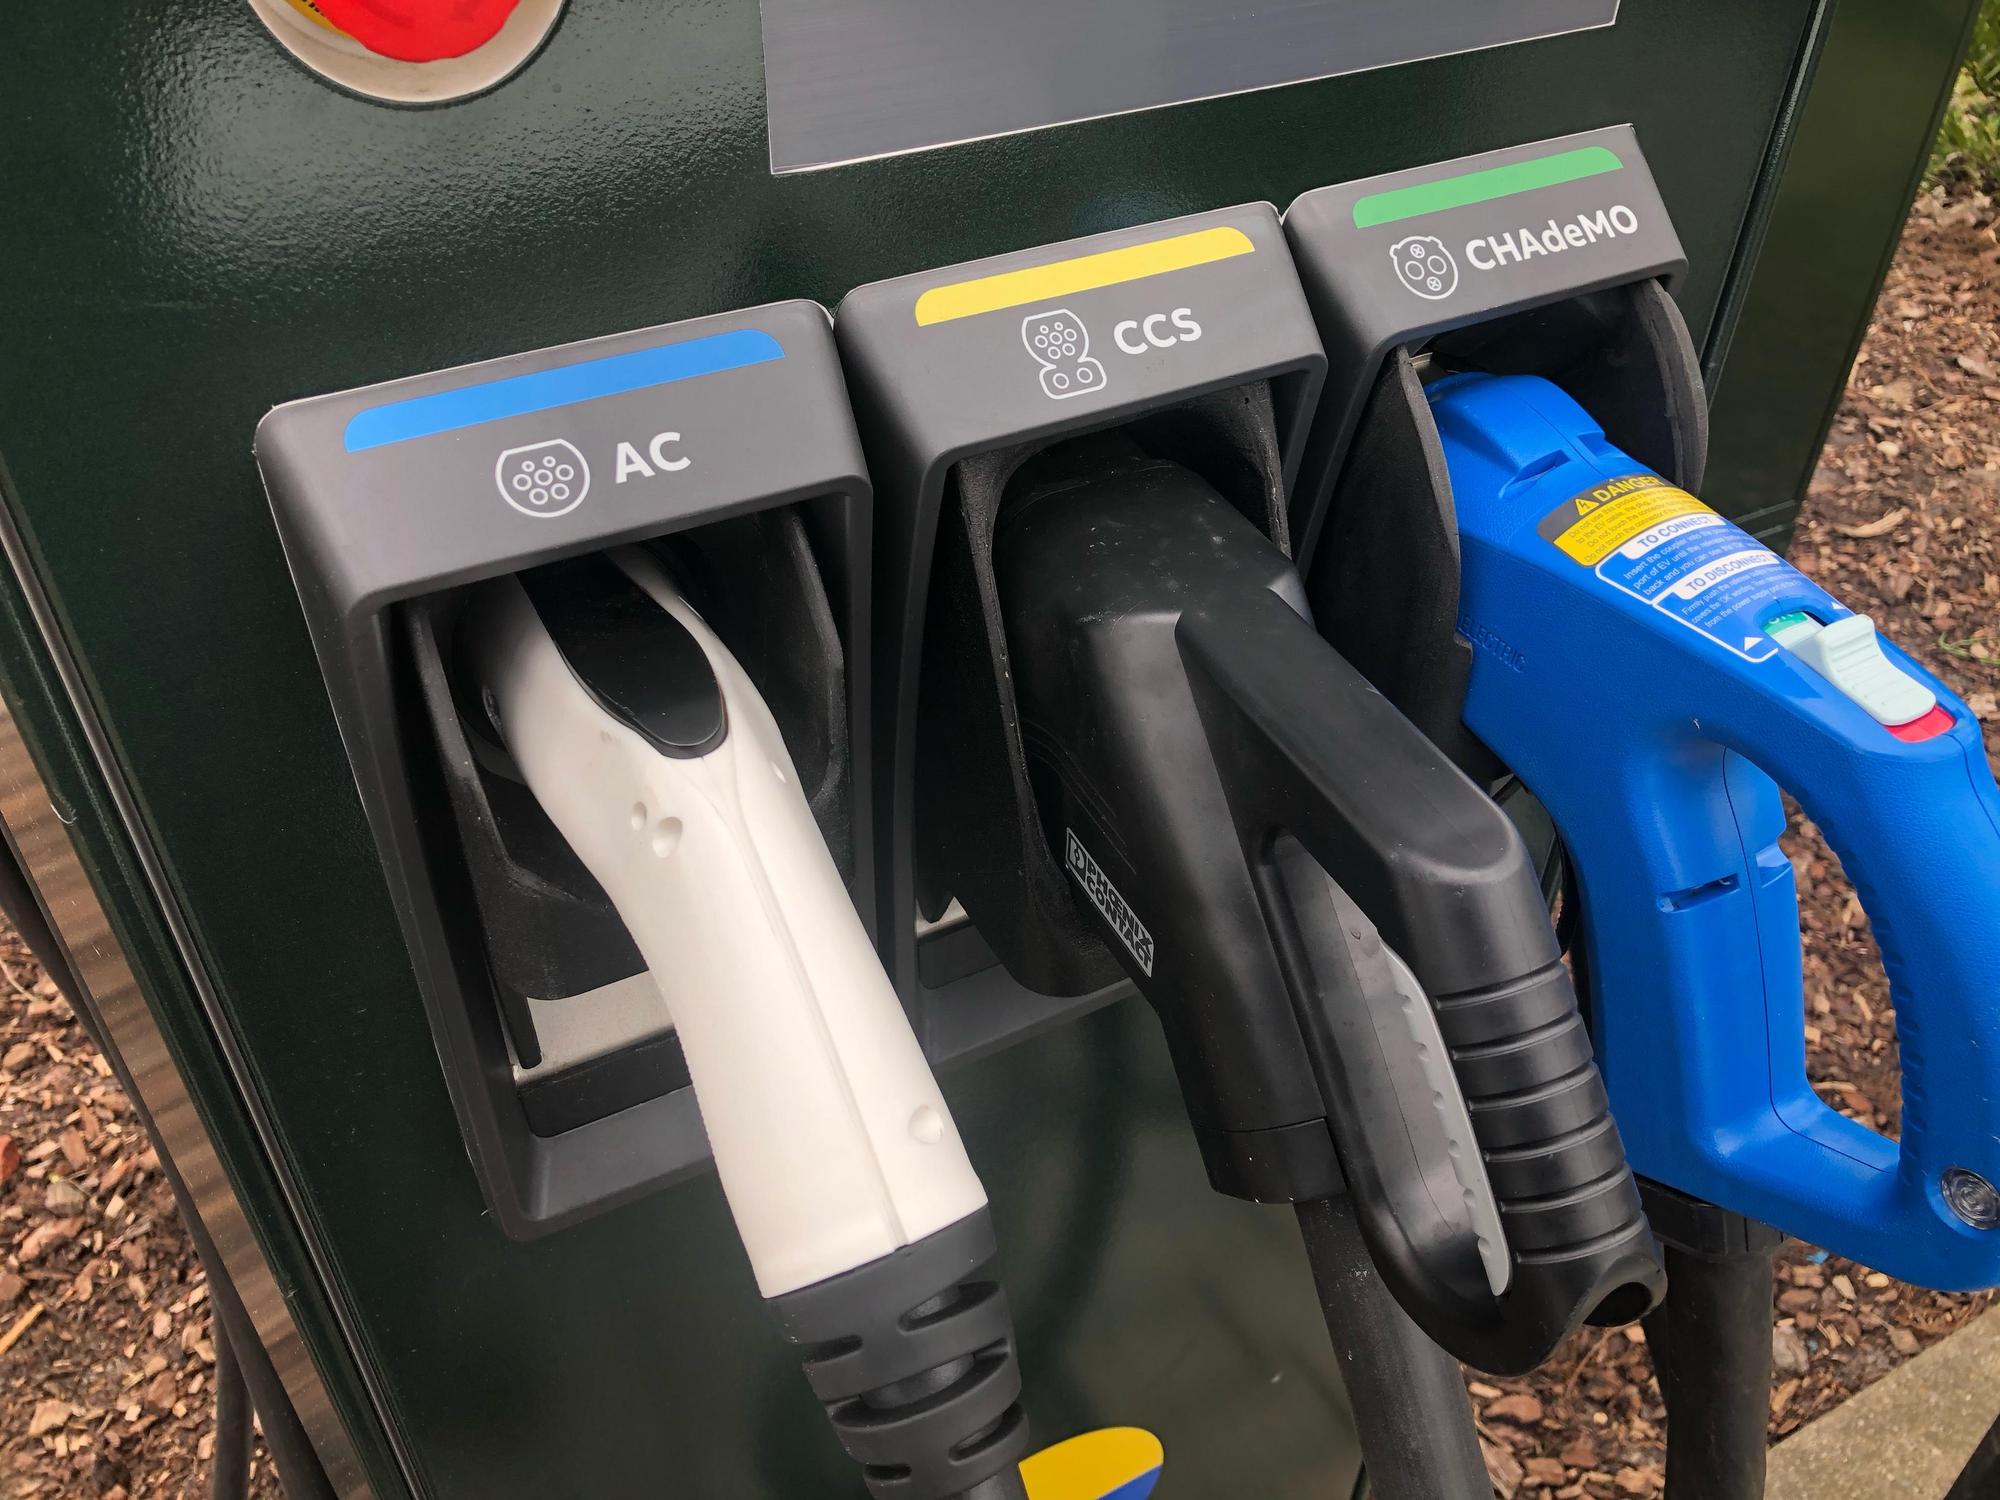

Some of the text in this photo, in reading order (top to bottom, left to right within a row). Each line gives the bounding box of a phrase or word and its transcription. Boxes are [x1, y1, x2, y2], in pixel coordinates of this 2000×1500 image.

[1465, 205, 1638, 270] CHAdeMO
[1113, 307, 1202, 355] CCS
[615, 431, 692, 485] AC
[1592, 476, 1665, 502] DANGER
[1637, 534, 1659, 547] TO
[1658, 516, 1712, 537] CONNECT
[1623, 561, 1648, 579] Insert
[1646, 553, 1661, 563] the
[1633, 574, 1651, 590] port
[1657, 559, 1670, 570] EV
[1671, 550, 1688, 562] until
[1643, 579, 1665, 595] back
[1664, 568, 1680, 581] and
[1680, 560, 1696, 572] you
[1686, 577, 1706, 591] TO
[1704, 554, 1770, 581] DISCONNECT
[1704, 615, 1722, 629] from
[1087, 875, 1152, 970] CONTACT
